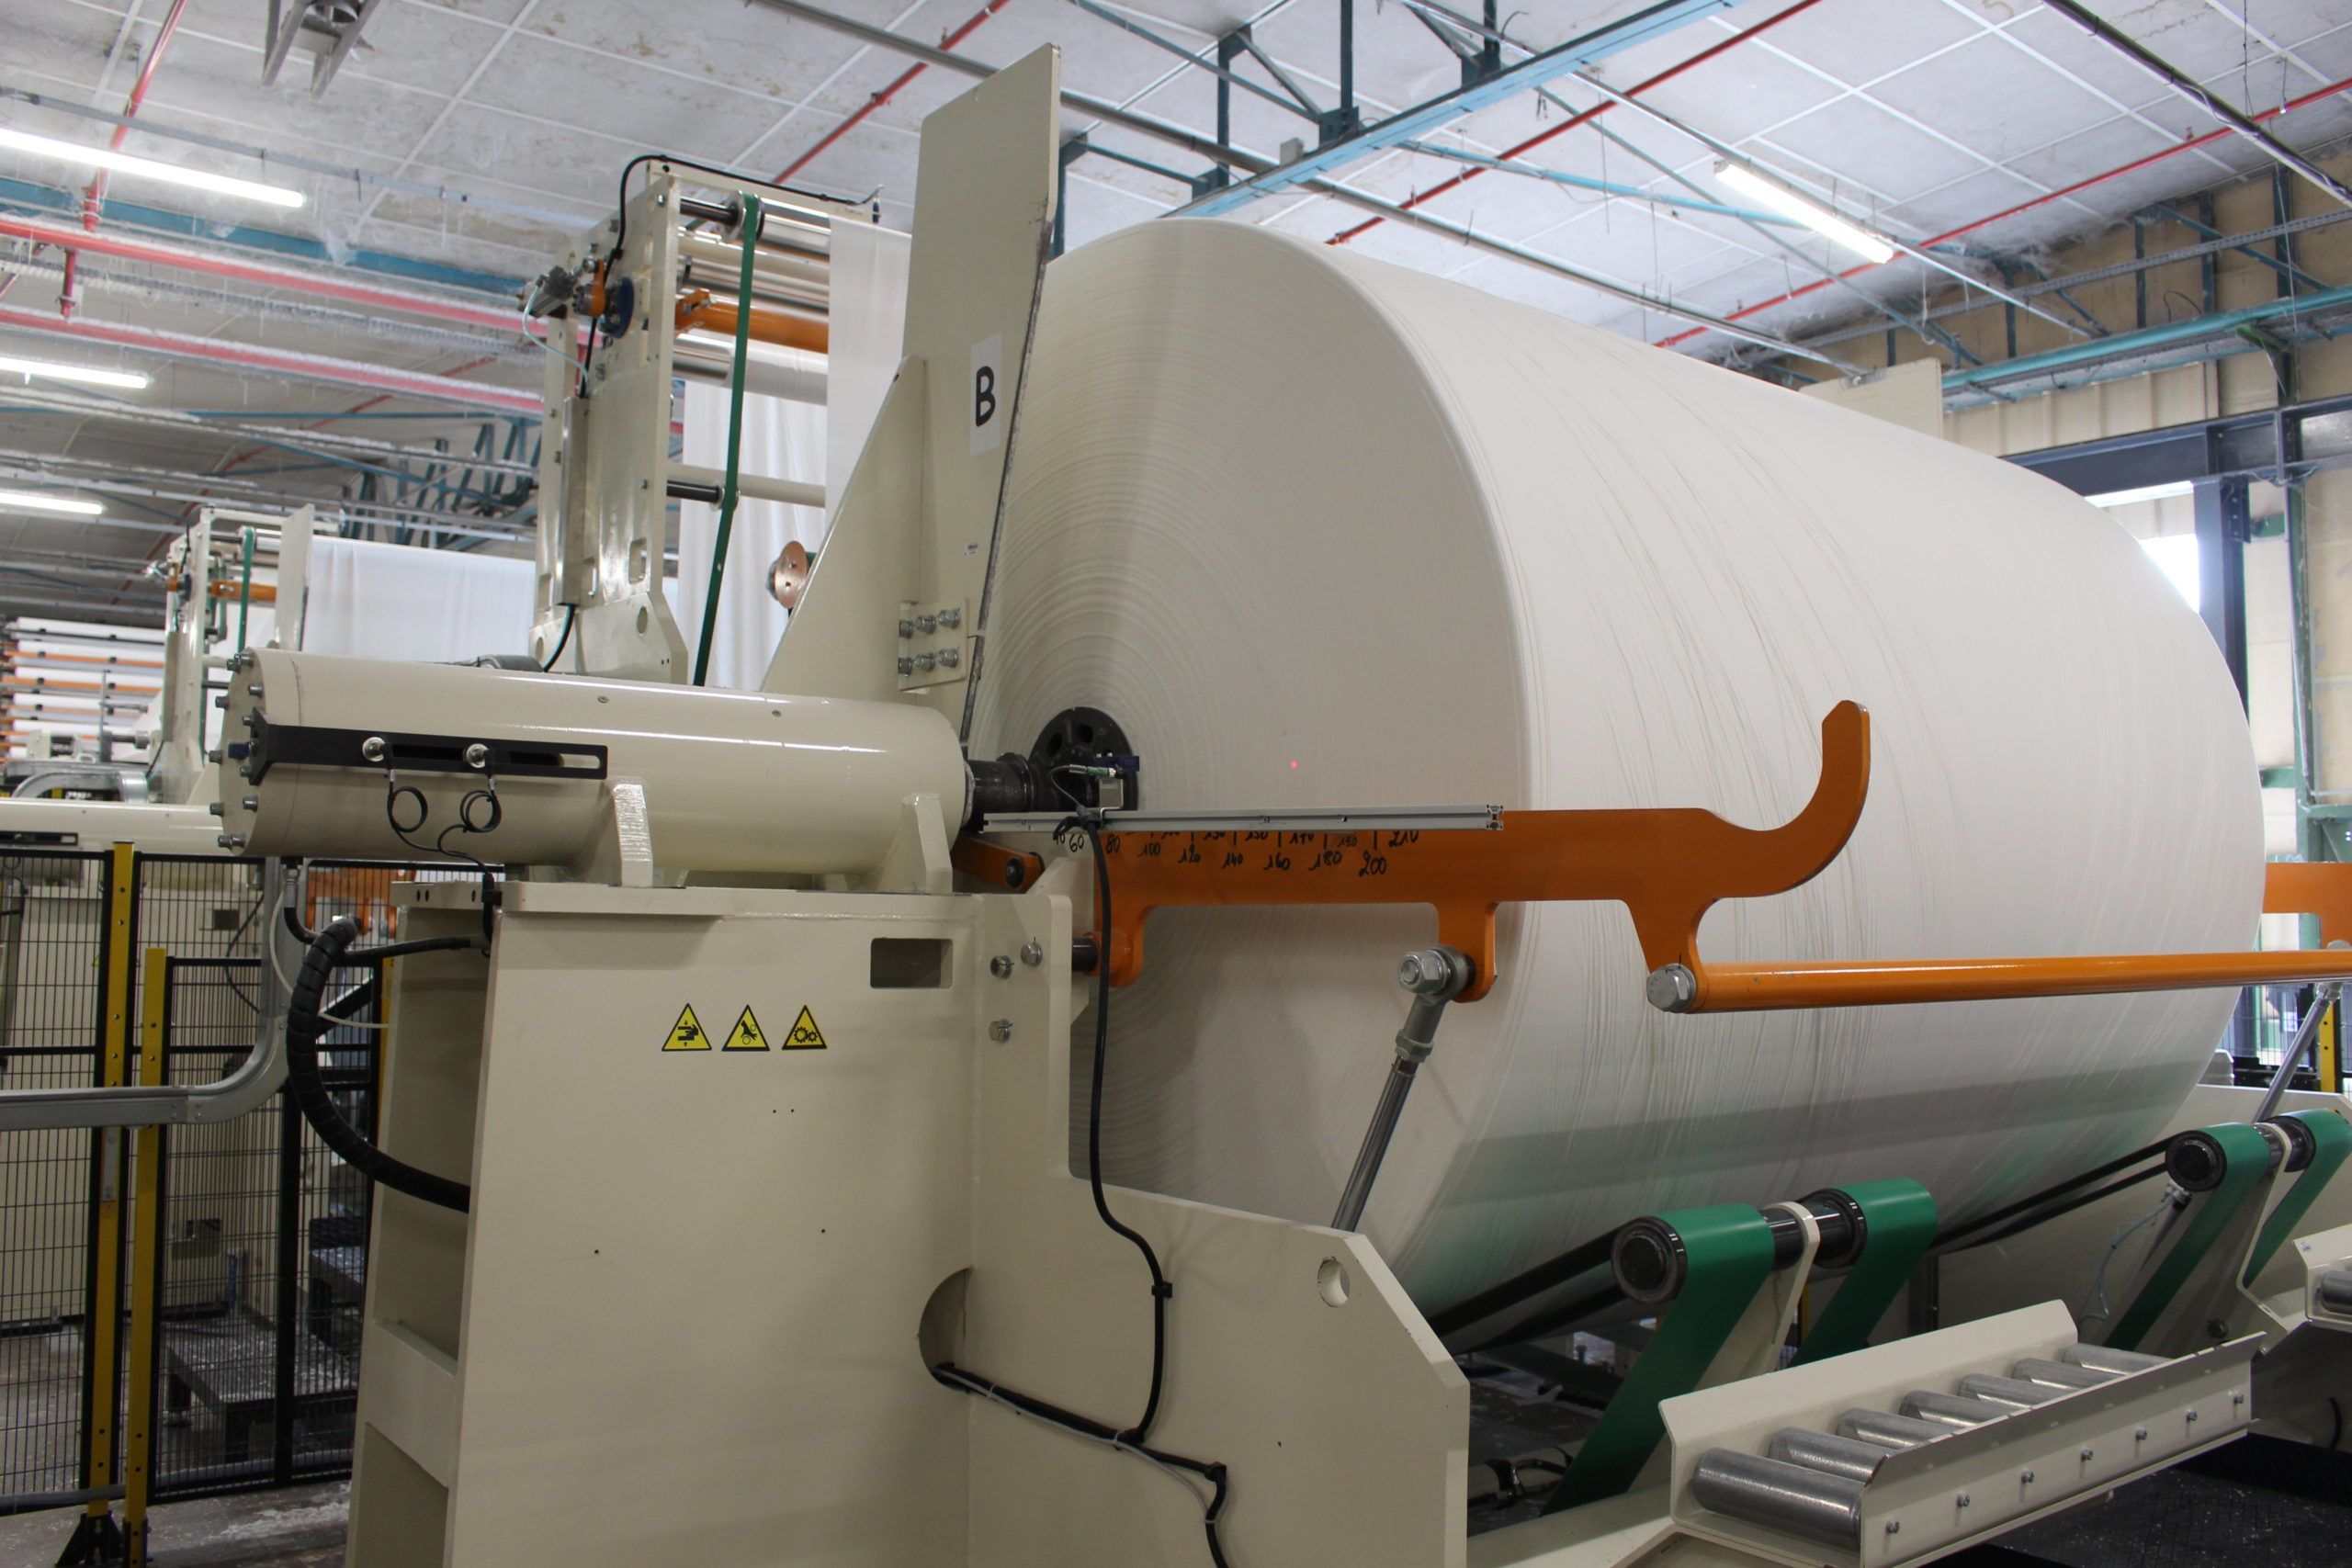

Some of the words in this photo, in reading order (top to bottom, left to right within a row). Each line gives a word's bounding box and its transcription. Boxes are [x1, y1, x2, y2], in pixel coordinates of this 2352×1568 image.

[975, 359, 996, 427] B
[1069, 834, 1084, 852] 60
[1105, 834, 1121, 854] 80
[1263, 852, 1290, 871] 160
[1308, 851, 1342, 871] 180
[1358, 850, 1387, 877] 200
